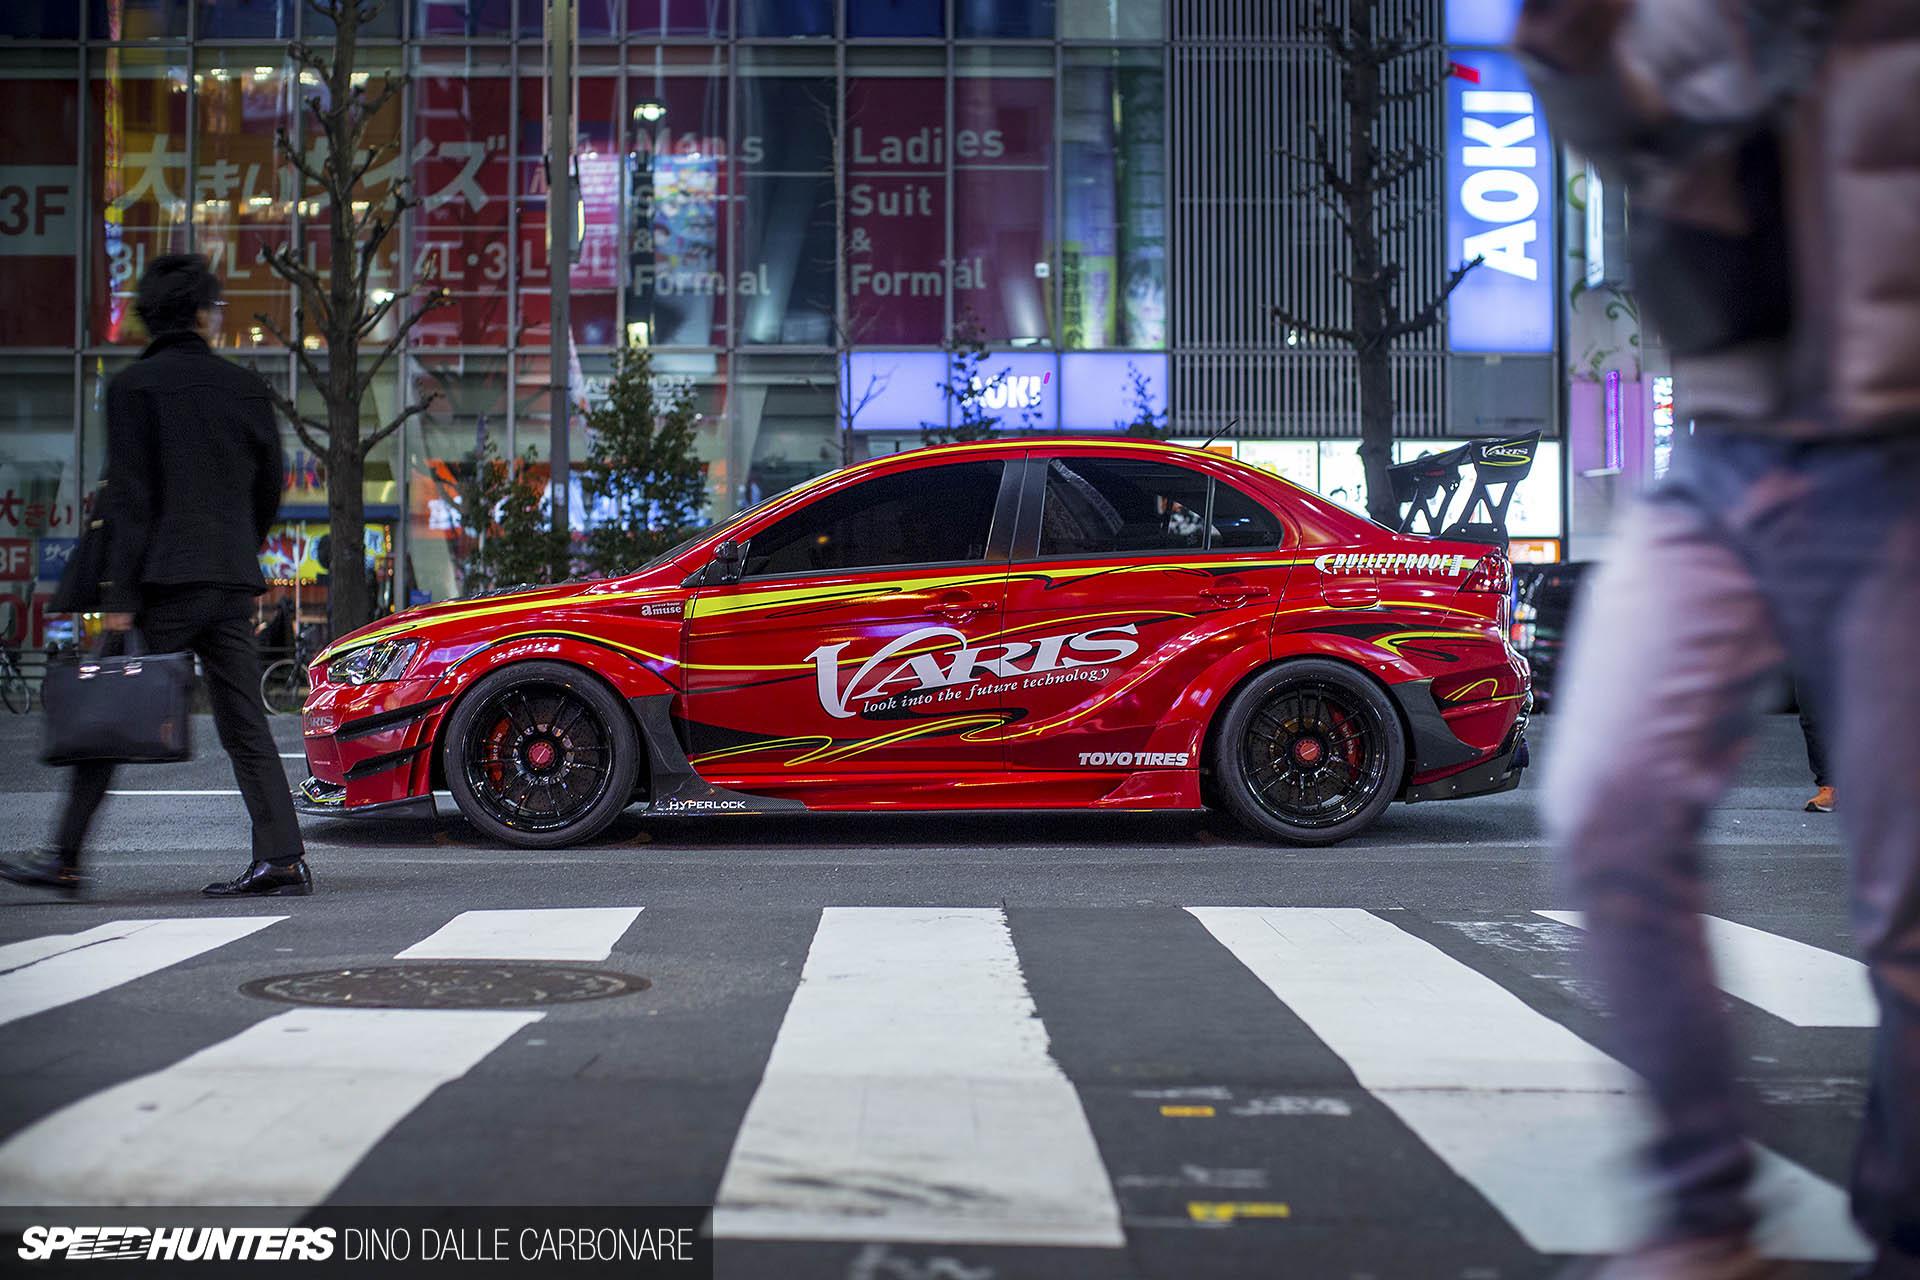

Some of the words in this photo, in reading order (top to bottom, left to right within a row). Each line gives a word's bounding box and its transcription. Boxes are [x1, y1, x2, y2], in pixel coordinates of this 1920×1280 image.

[853, 127, 1005, 164] Ladies
[850, 184, 932, 216] Suit
[1460, 91, 1539, 281] AOKI
[0, 185, 69, 236] 3F
[851, 228, 872, 252] &
[633, 263, 771, 297] Formal
[852, 257, 987, 297] Formal
[641, 604, 682, 616] amuse
[803, 623, 1139, 719] VARIS
[864, 699, 897, 714] look
[901, 694, 932, 708] into
[938, 688, 962, 702] the
[965, 682, 1017, 700] future
[1023, 667, 1110, 688] technology
[1079, 752, 1133, 766] TOYO
[1134, 752, 1189, 767] TIRES
[669, 800, 746, 810] HYPERLOCK
